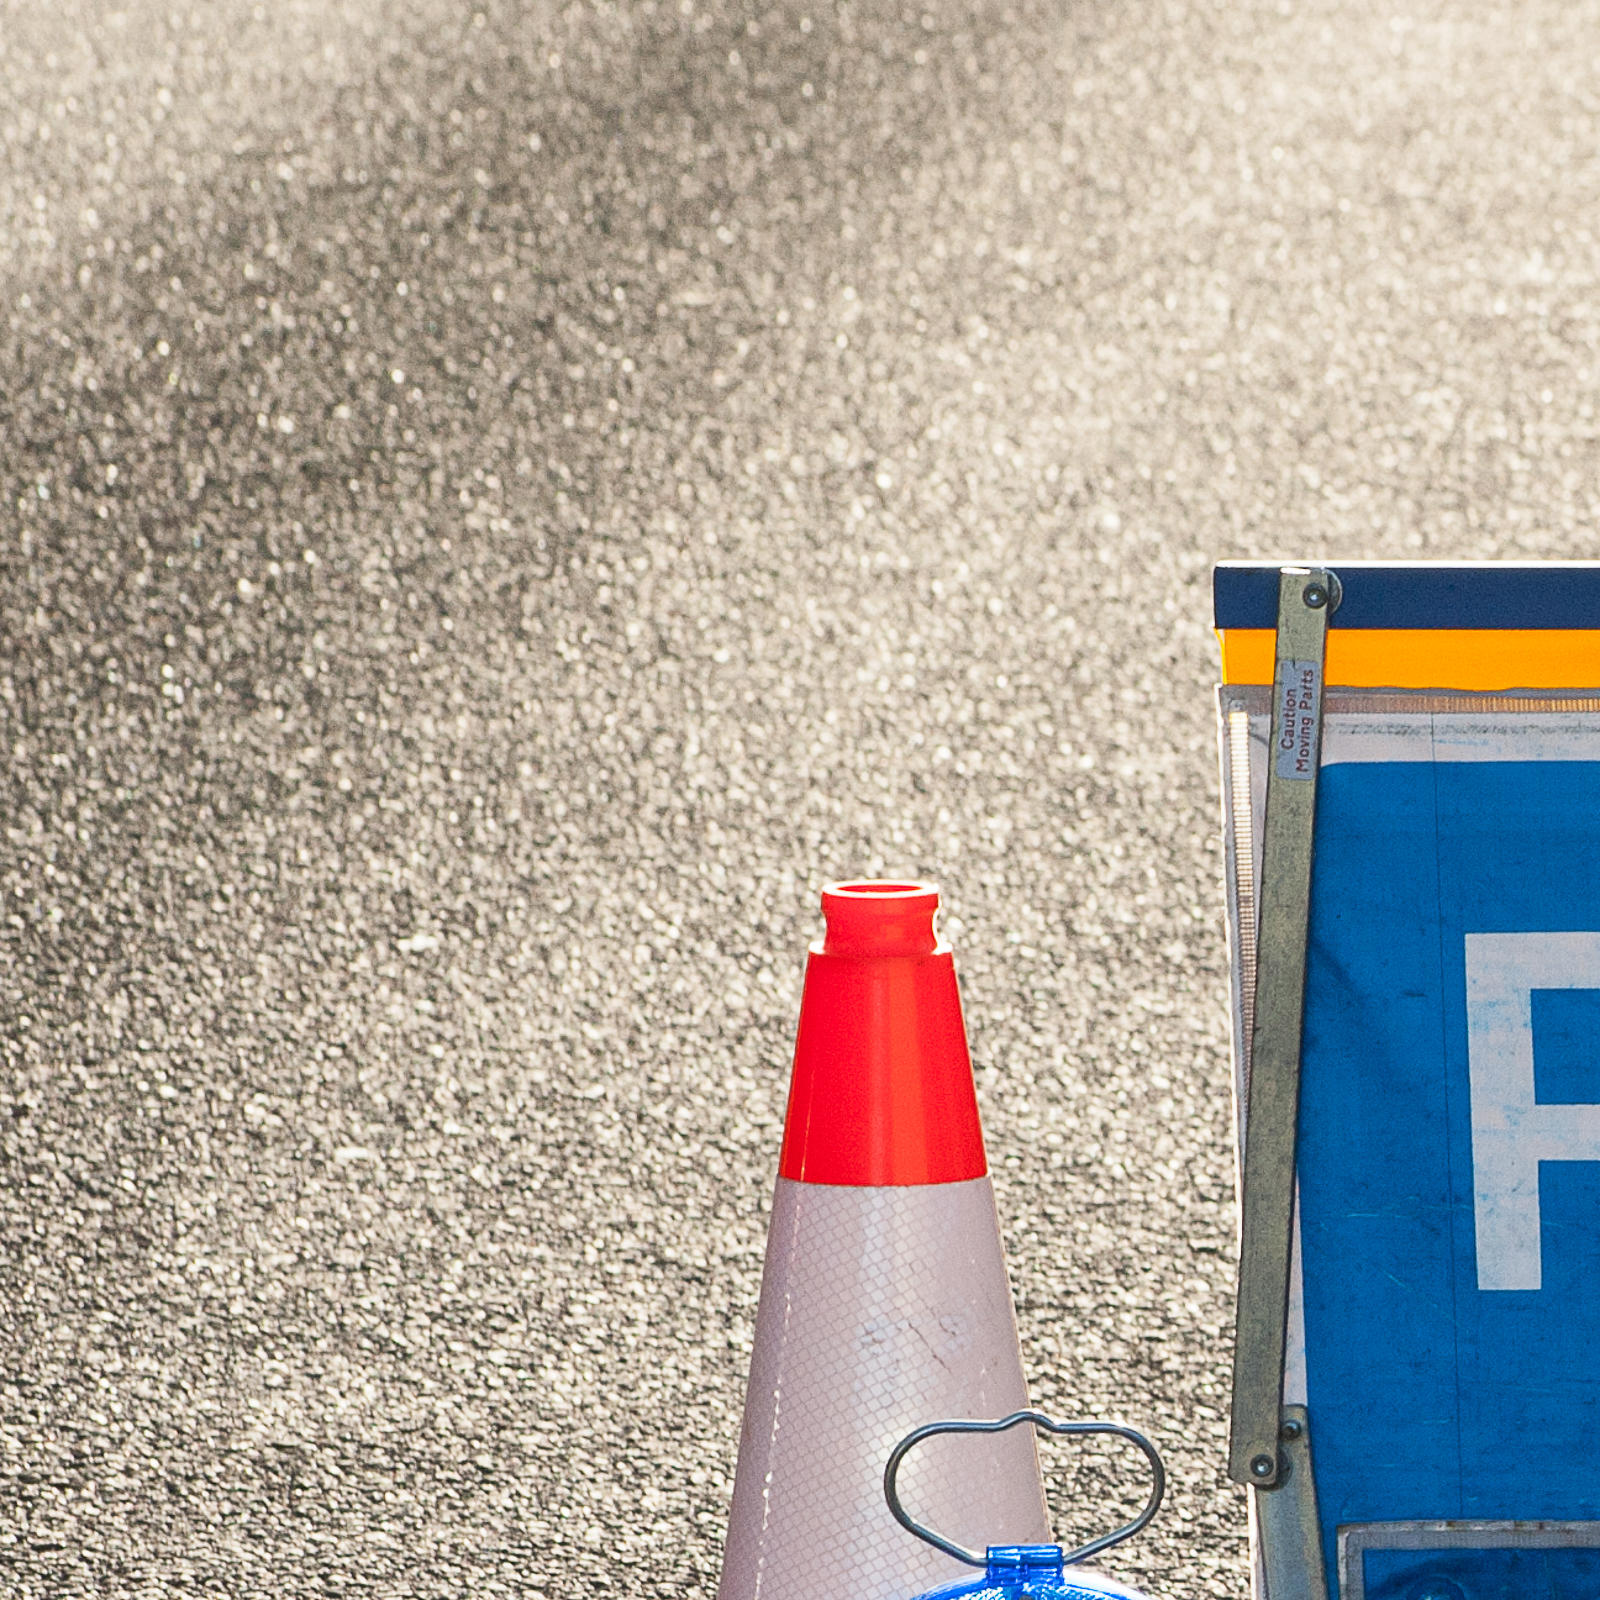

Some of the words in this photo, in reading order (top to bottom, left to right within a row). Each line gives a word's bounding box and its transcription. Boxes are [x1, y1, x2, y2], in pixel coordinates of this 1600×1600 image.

[1299, 669, 1314, 710] Parts
[1280, 688, 1297, 750] Caution
[1295, 717, 1314, 772] Moving
